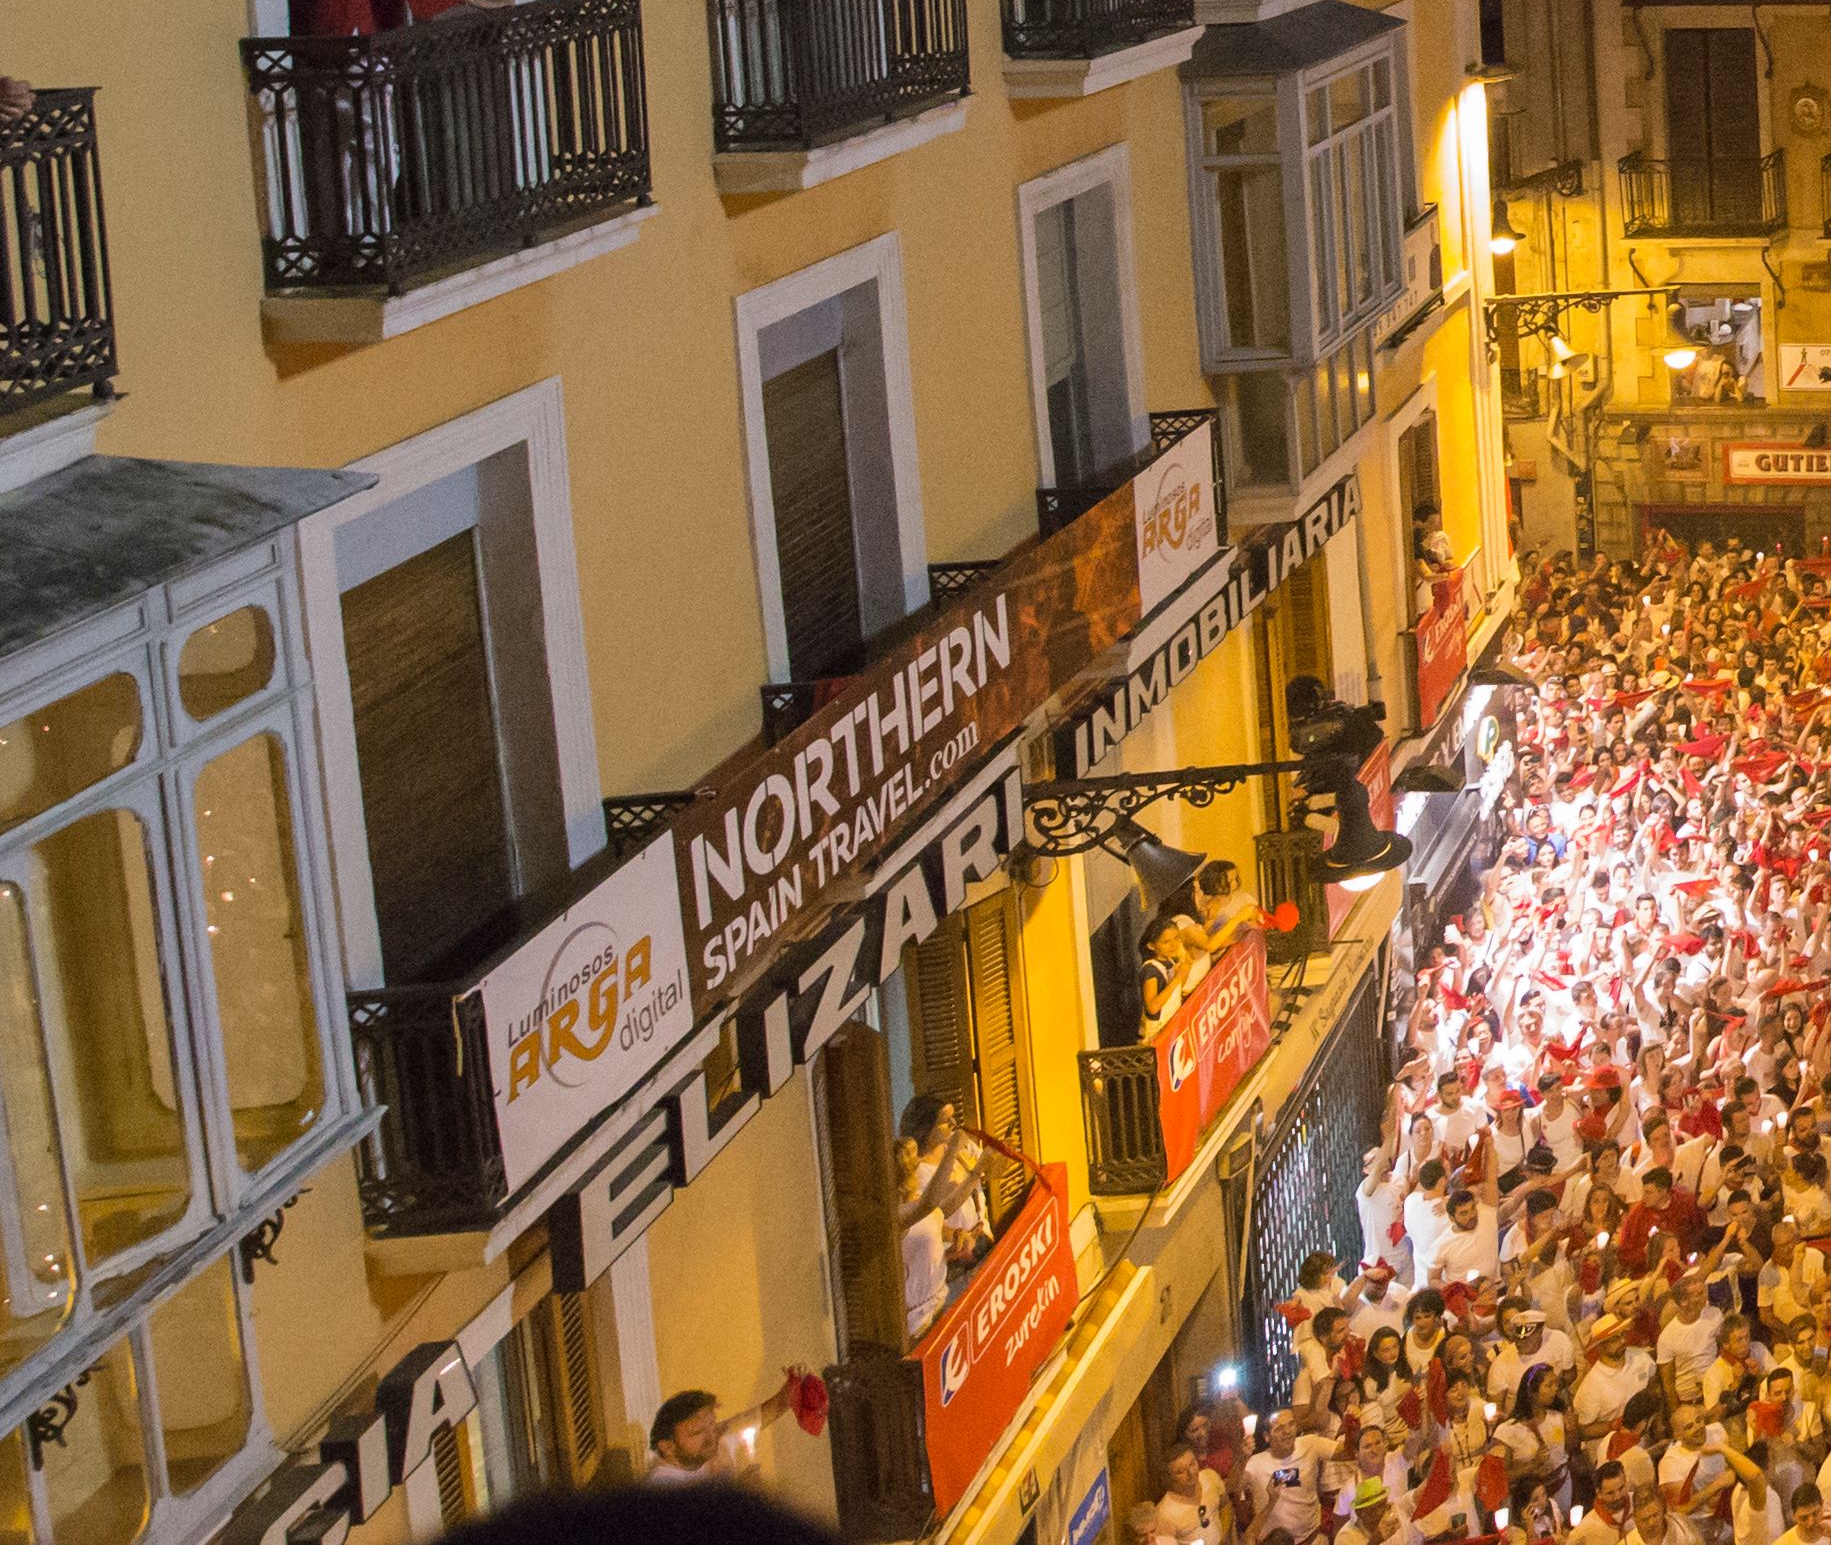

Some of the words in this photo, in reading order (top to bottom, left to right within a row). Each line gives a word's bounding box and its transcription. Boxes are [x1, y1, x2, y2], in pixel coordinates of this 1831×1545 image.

[1075, 477, 1362, 779] INMOBILIARIA
[690, 593, 1011, 930] NORTHERN
[706, 864, 803, 990] SPAIN
[809, 720, 980, 889] TRAVEL.com
[506, 935, 652, 1105] ARGA
[508, 945, 613, 1048] Luminosos
[580, 767, 1025, 1291] ELIZARI
[619, 969, 684, 1052] digital
[1198, 955, 1254, 1047] EROSKI
[976, 1213, 1053, 1345] EROSKI
[1005, 1275, 1061, 1367] zurekin
